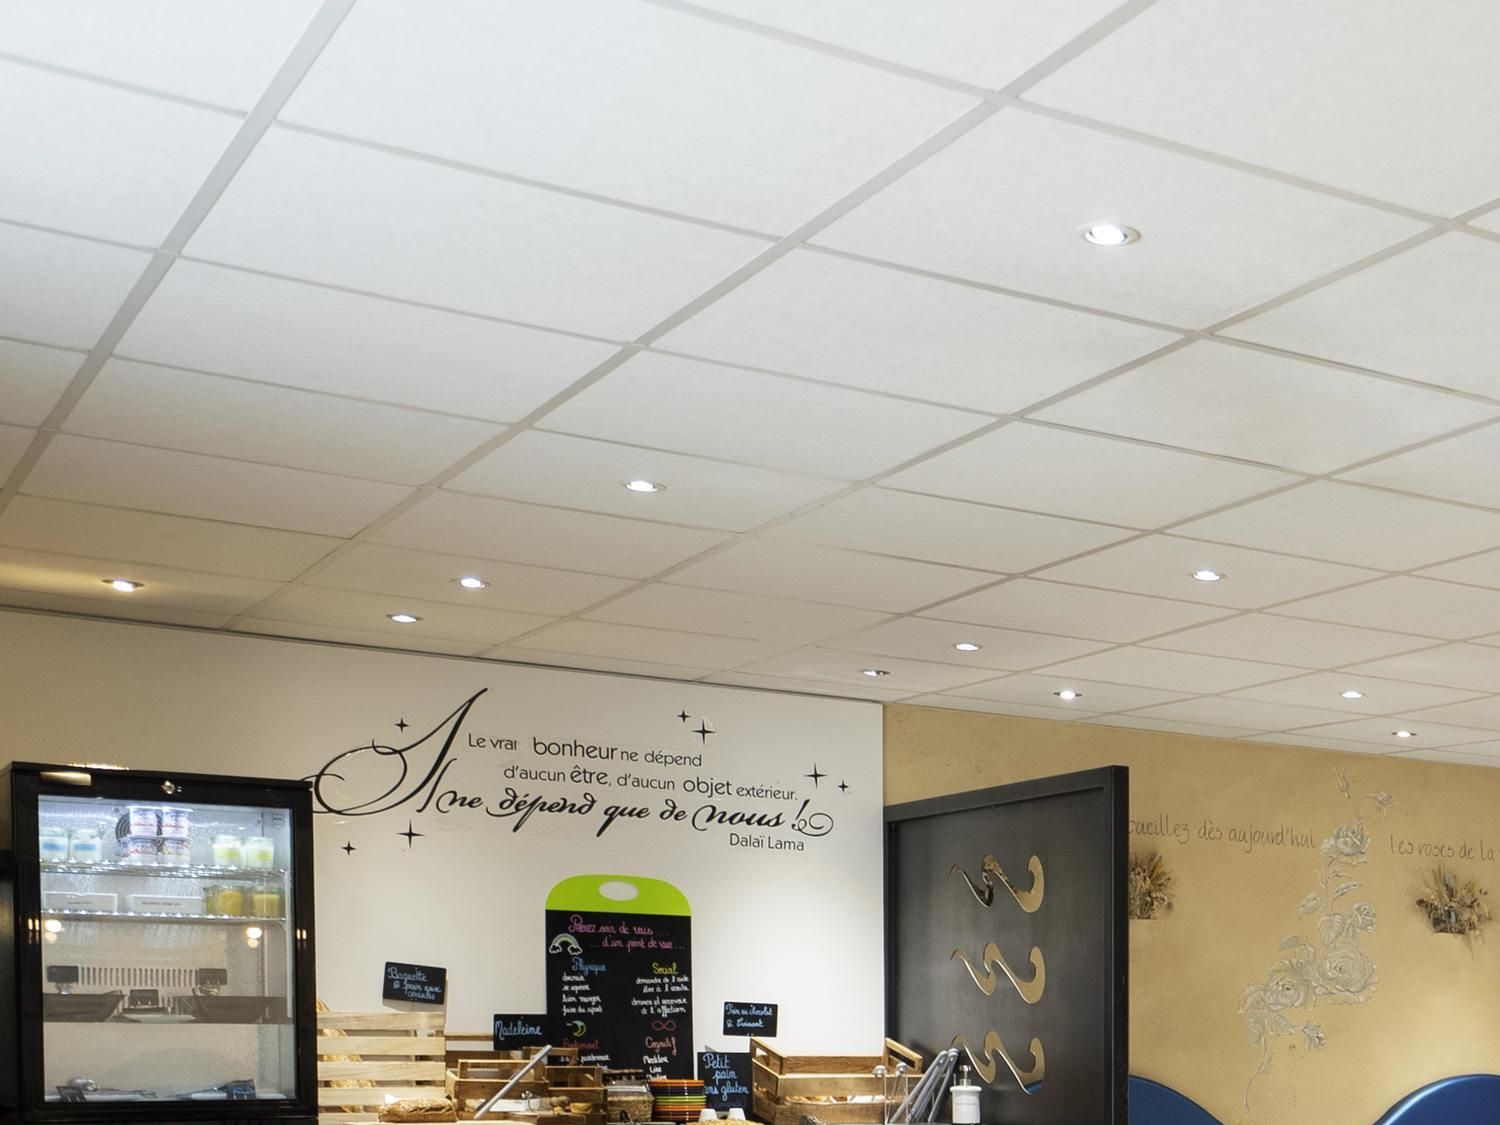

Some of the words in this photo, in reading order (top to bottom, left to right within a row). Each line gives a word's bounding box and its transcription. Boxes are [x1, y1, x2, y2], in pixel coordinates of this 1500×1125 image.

[468, 733, 486, 748] Le
[490, 740, 517, 750] vrai
[533, 737, 618, 761] bonheur
[620, 752, 639, 762] ne
[644, 750, 702, 767] dépend
[504, 765, 566, 782] d'aucun
[570, 765, 612, 787] être,
[617, 773, 676, 791] d'aucun
[683, 777, 733, 798] objet
[736, 783, 798, 801] extérieur.
[486, 787, 598, 833] dépend
[596, 804, 651, 838] que
[660, 798, 688, 822] de
[692, 804, 785, 832] nous
[729, 832, 764, 849] Dalaï
[768, 836, 805, 851] Lama
[1197, 820, 1223, 841] dès
[1228, 824, 1316, 853] aujourd'hui
[1390, 833, 1414, 855] les
[1417, 843, 1455, 858] roses
[1458, 842, 1475, 860] de
[1479, 839, 1495, 862] la
[619, 922, 630, 935] de
[648, 938, 658, 949] de
[652, 962, 678, 975] Social
[495, 1021, 542, 1040] Madeleine
[703, 1053, 730, 1068] Petit
[712, 1071, 737, 1085] pain
[721, 1081, 749, 1101] gluten
